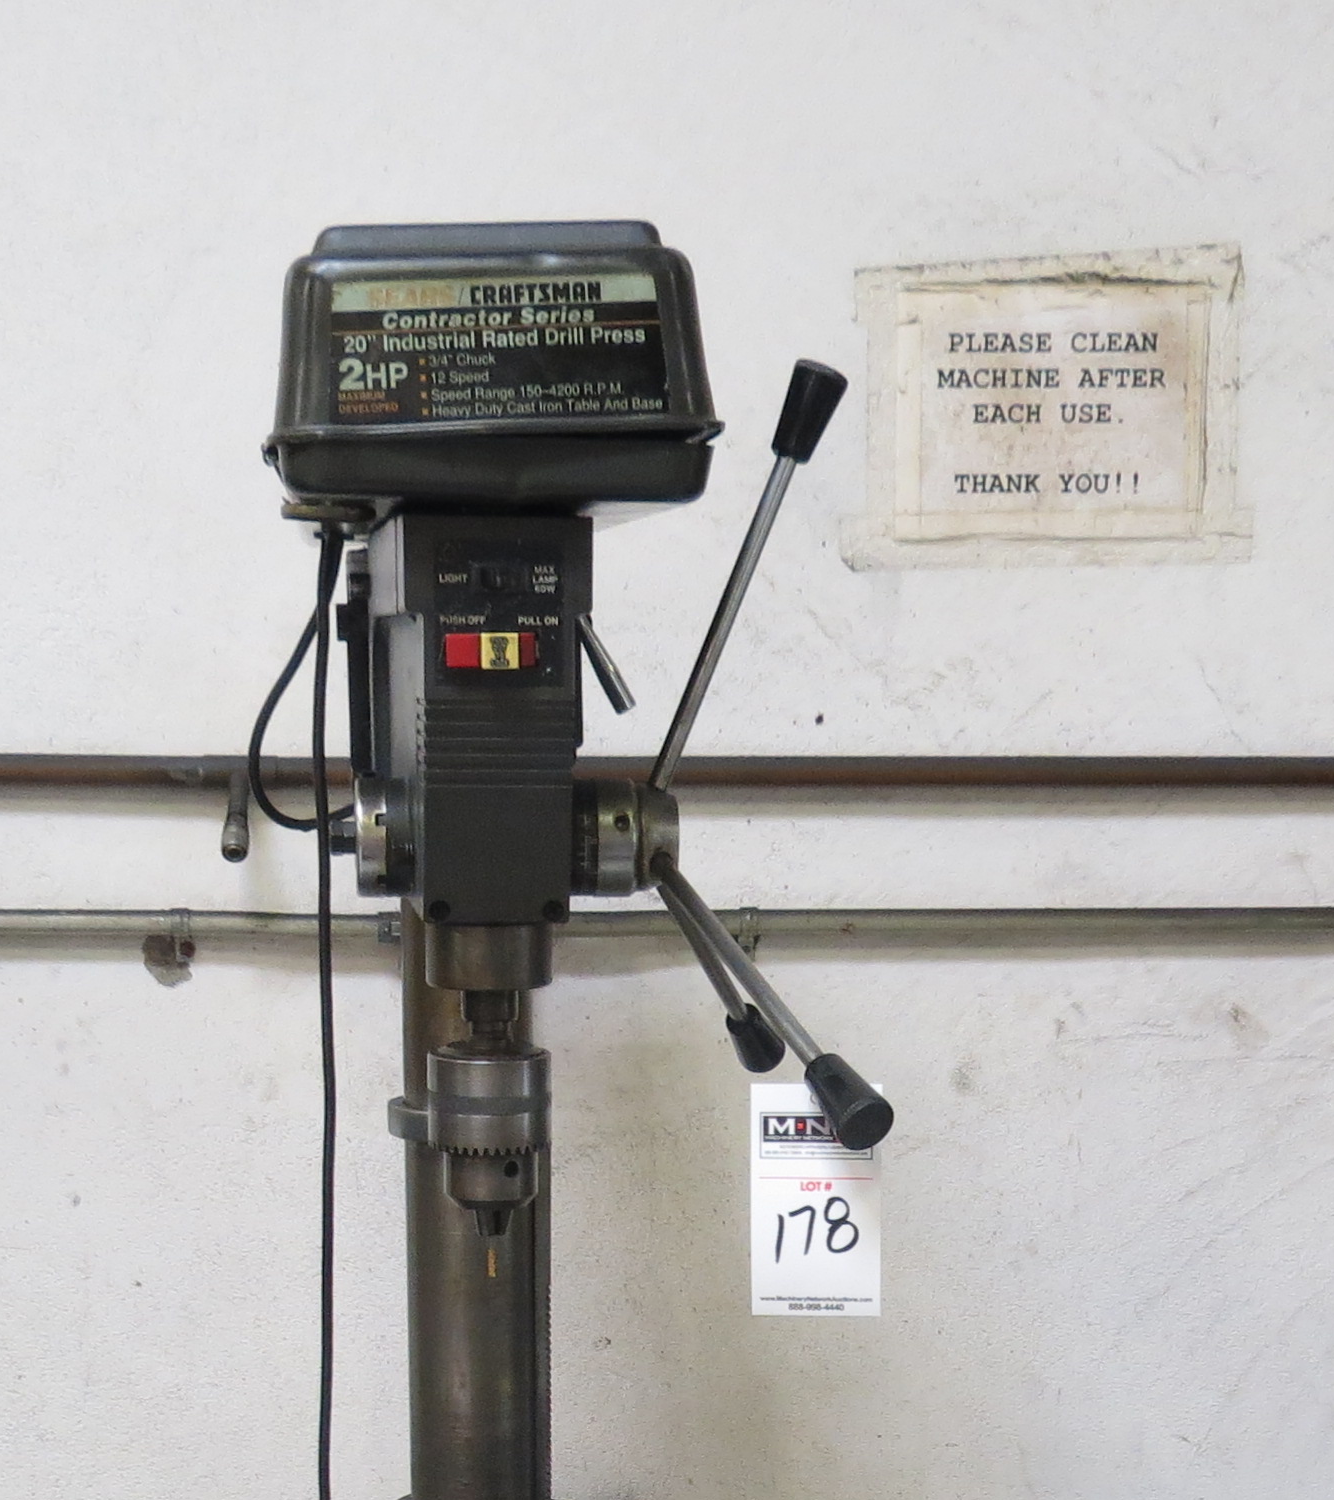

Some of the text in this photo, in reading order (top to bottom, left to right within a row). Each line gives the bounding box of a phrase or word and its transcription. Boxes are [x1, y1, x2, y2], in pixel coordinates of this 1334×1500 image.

[470, 282, 601, 304] CRAFTSMAN
[382, 306, 595, 330] Contractor Series
[343, 326, 646, 353] 20" Industrial Rated Drill Press
[948, 332, 1159, 354] PLEASE CLEAN
[456, 352, 495, 367] Chuck
[338, 357, 409, 391] 2HP
[449, 370, 490, 386] Speed
[936, 368, 1167, 389] MACHINE AFTER
[431, 388, 471, 402] Speed
[475, 386, 515, 401] Range
[432, 396, 663, 418] Heavy Duty Cast Iron Table And Base
[972, 403, 1125, 424] EACH USE.
[954, 472, 1141, 494] THANK YOU!!
[438, 573, 467, 583] LIGHT
[439, 615, 487, 625] PUSH OFF
[518, 616, 559, 626] PULL ON
[800, 1181, 833, 1192] LOT #
[774, 1196, 860, 1264] 178
